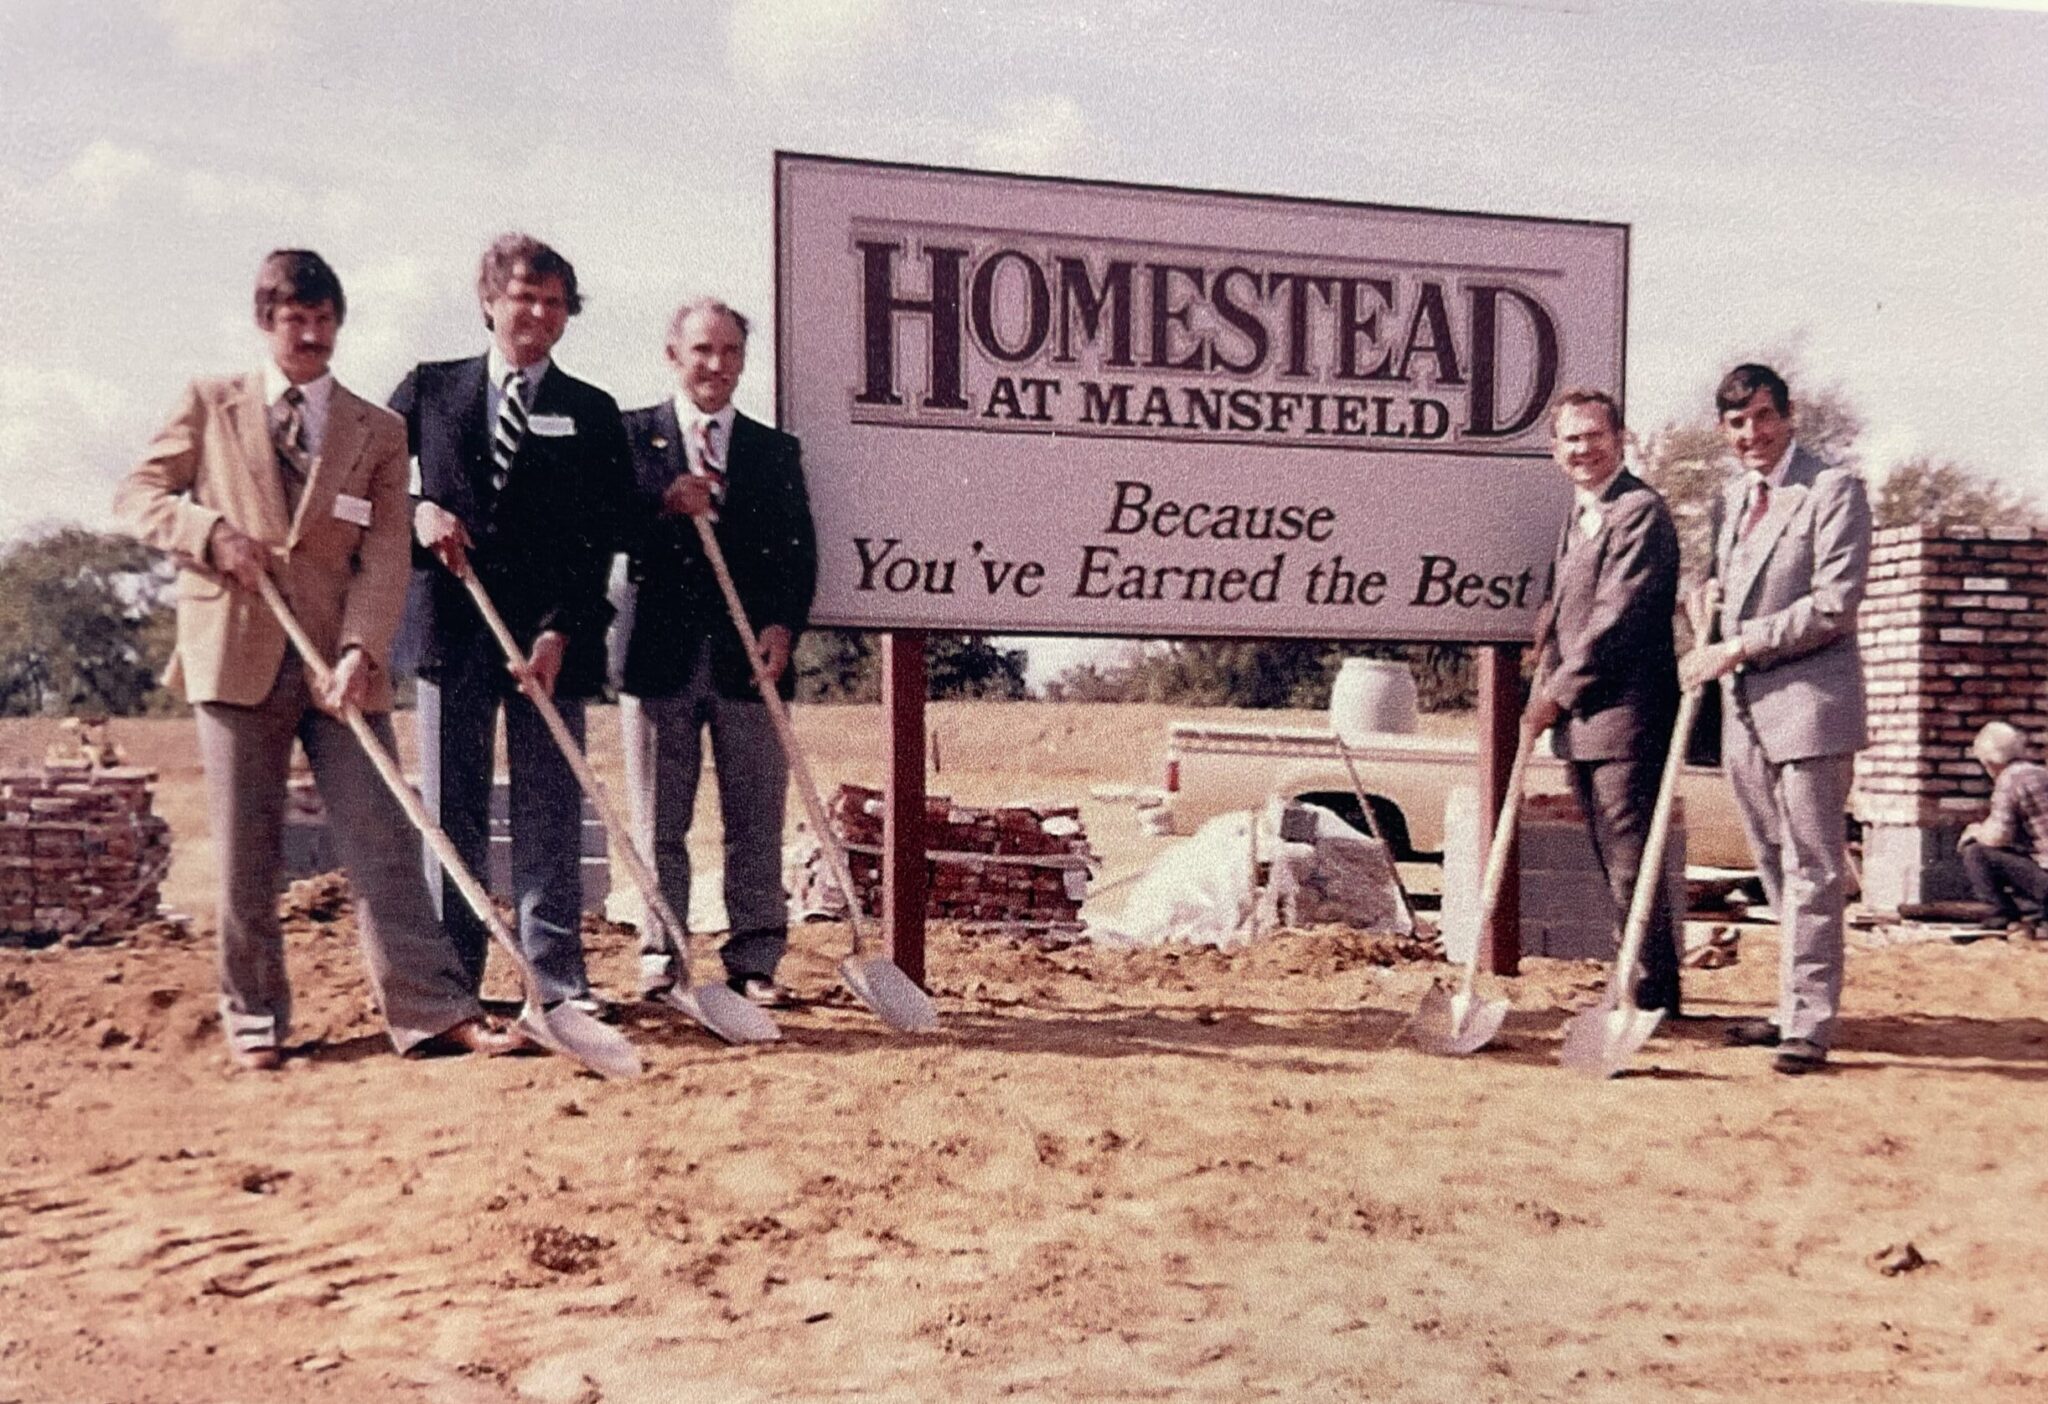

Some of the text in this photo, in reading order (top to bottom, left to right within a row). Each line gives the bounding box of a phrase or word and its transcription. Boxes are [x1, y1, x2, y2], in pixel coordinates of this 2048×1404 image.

[856, 241, 1559, 438] HOMESTEAD
[981, 377, 1449, 439] AT MANSFIELD
[1105, 481, 1336, 542] Because
[853, 538, 1532, 610] You've Earned the Best
